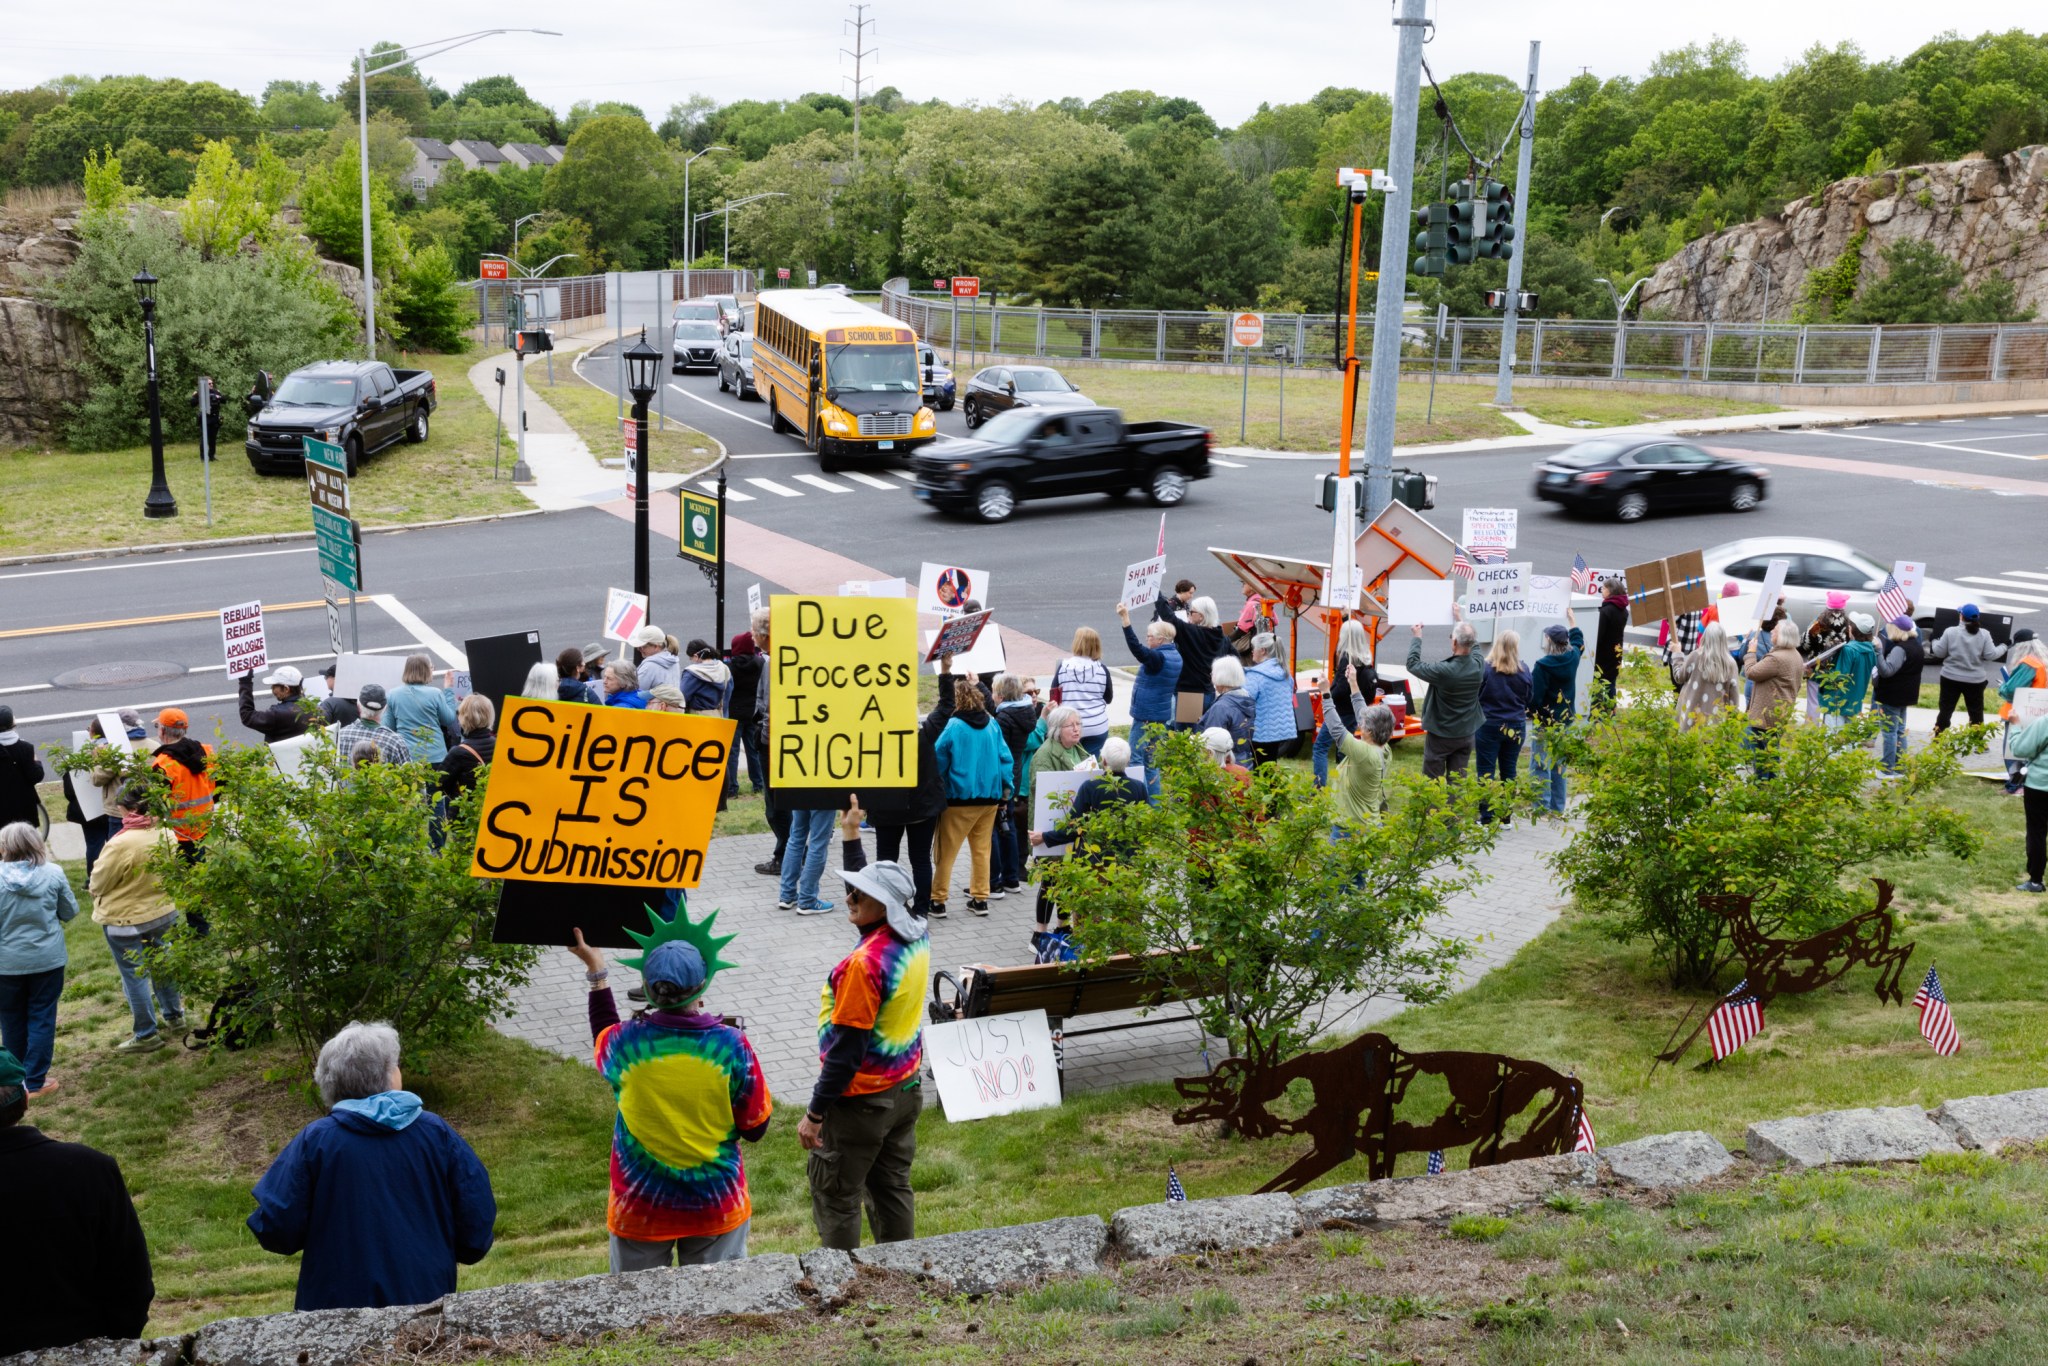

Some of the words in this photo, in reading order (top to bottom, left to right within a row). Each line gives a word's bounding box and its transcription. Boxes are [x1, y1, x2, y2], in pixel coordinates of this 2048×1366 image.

[848, 331, 877, 341] SCHOOL
[878, 331, 893, 341] BUS
[689, 502, 711, 515] MCKINLEY
[694, 540, 705, 550] PARK
[1128, 563, 1160, 581] SHAME
[1478, 568, 1518, 582] CHECKS
[1137, 579, 1146, 587] ON
[1491, 585, 1508, 595] and
[1131, 587, 1152, 606] YOU!
[223, 604, 260, 624] REBUILD
[1469, 600, 1525, 614] BALANCES
[1526, 602, 1559, 613] EFUGEE
[226, 620, 262, 640] REHIRE
[329, 614, 342, 647] 32
[798, 601, 887, 640] Due
[952, 615, 982, 627] STOP
[227, 637, 265, 658] APOLOGIZE
[941, 635, 972, 647] STOP
[230, 653, 266, 674] RESIGN
[779, 645, 910, 688] Process
[786, 695, 830, 725] Is
[860, 694, 884, 722] A
[507, 705, 725, 781] Silence
[779, 730, 914, 780] RIGHT
[558, 774, 650, 826] IS
[476, 800, 704, 883] Submission
[946, 1015, 1026, 1067] JUST
[969, 1053, 1036, 1104] NO!
